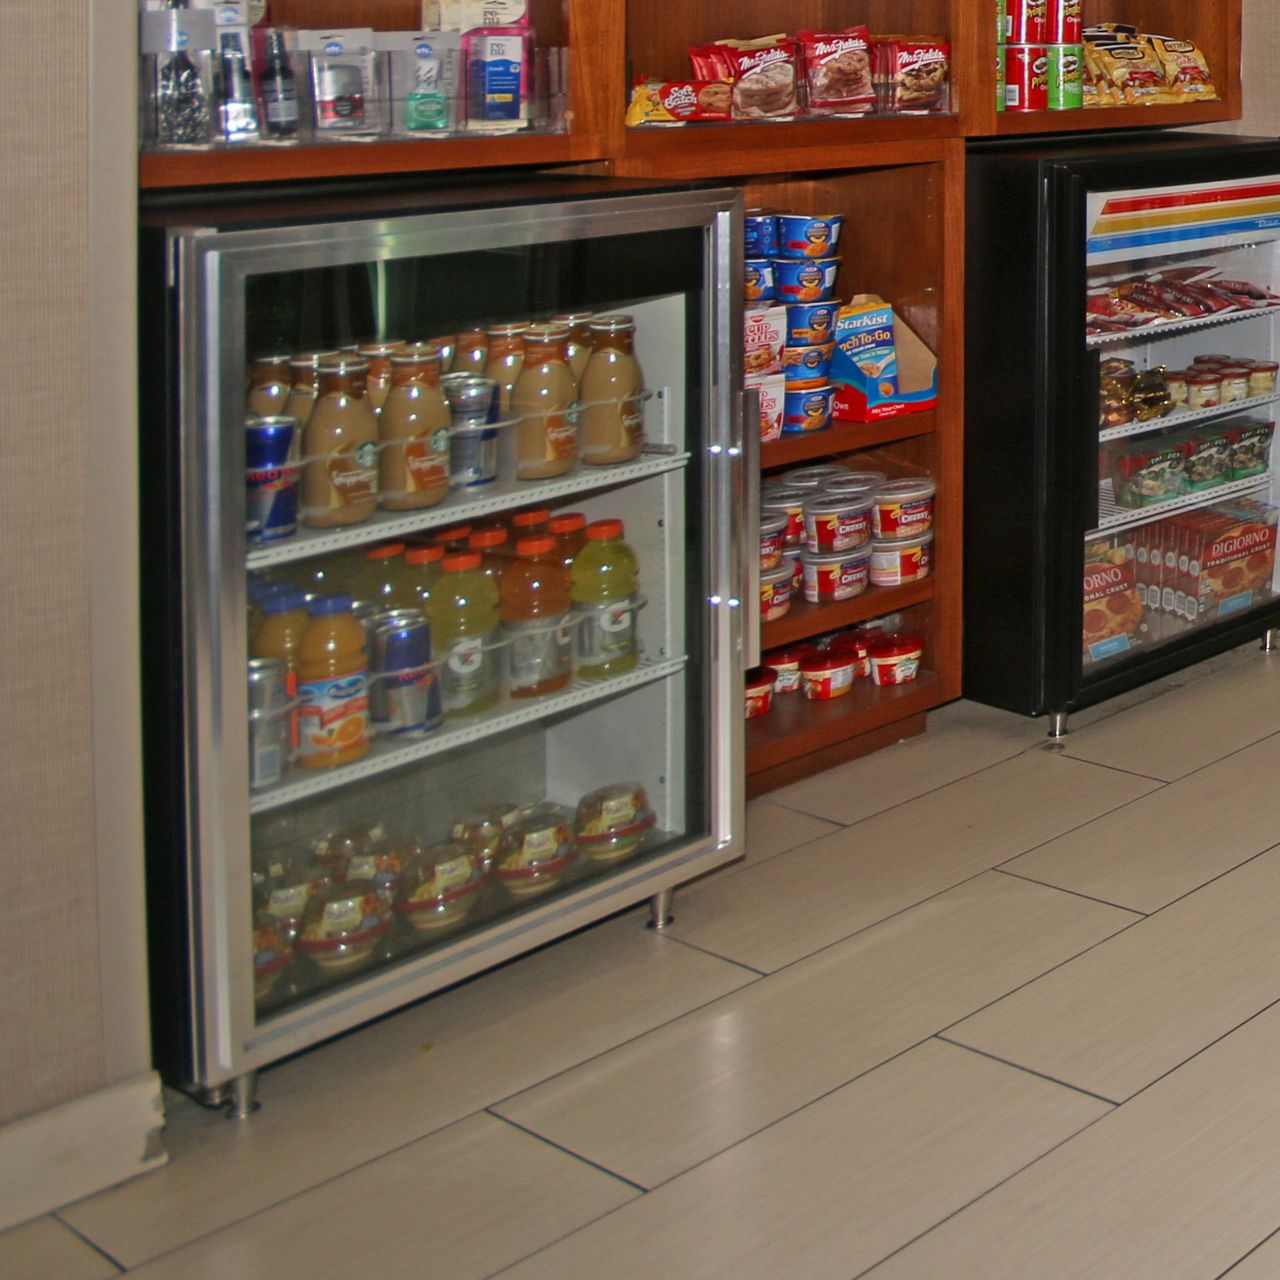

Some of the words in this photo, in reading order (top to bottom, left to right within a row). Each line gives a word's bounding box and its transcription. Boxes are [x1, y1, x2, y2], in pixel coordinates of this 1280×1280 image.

[670, 86, 694, 99] Soft
[665, 96, 698, 109] Batch
[836, 314, 888, 331] StarKist
[1211, 528, 1269, 558] DIGIORNO
[1206, 549, 1249, 568] TRADITIONAL
[1250, 542, 1271, 555] CRUST
[1105, 582, 1129, 595] CRUST
